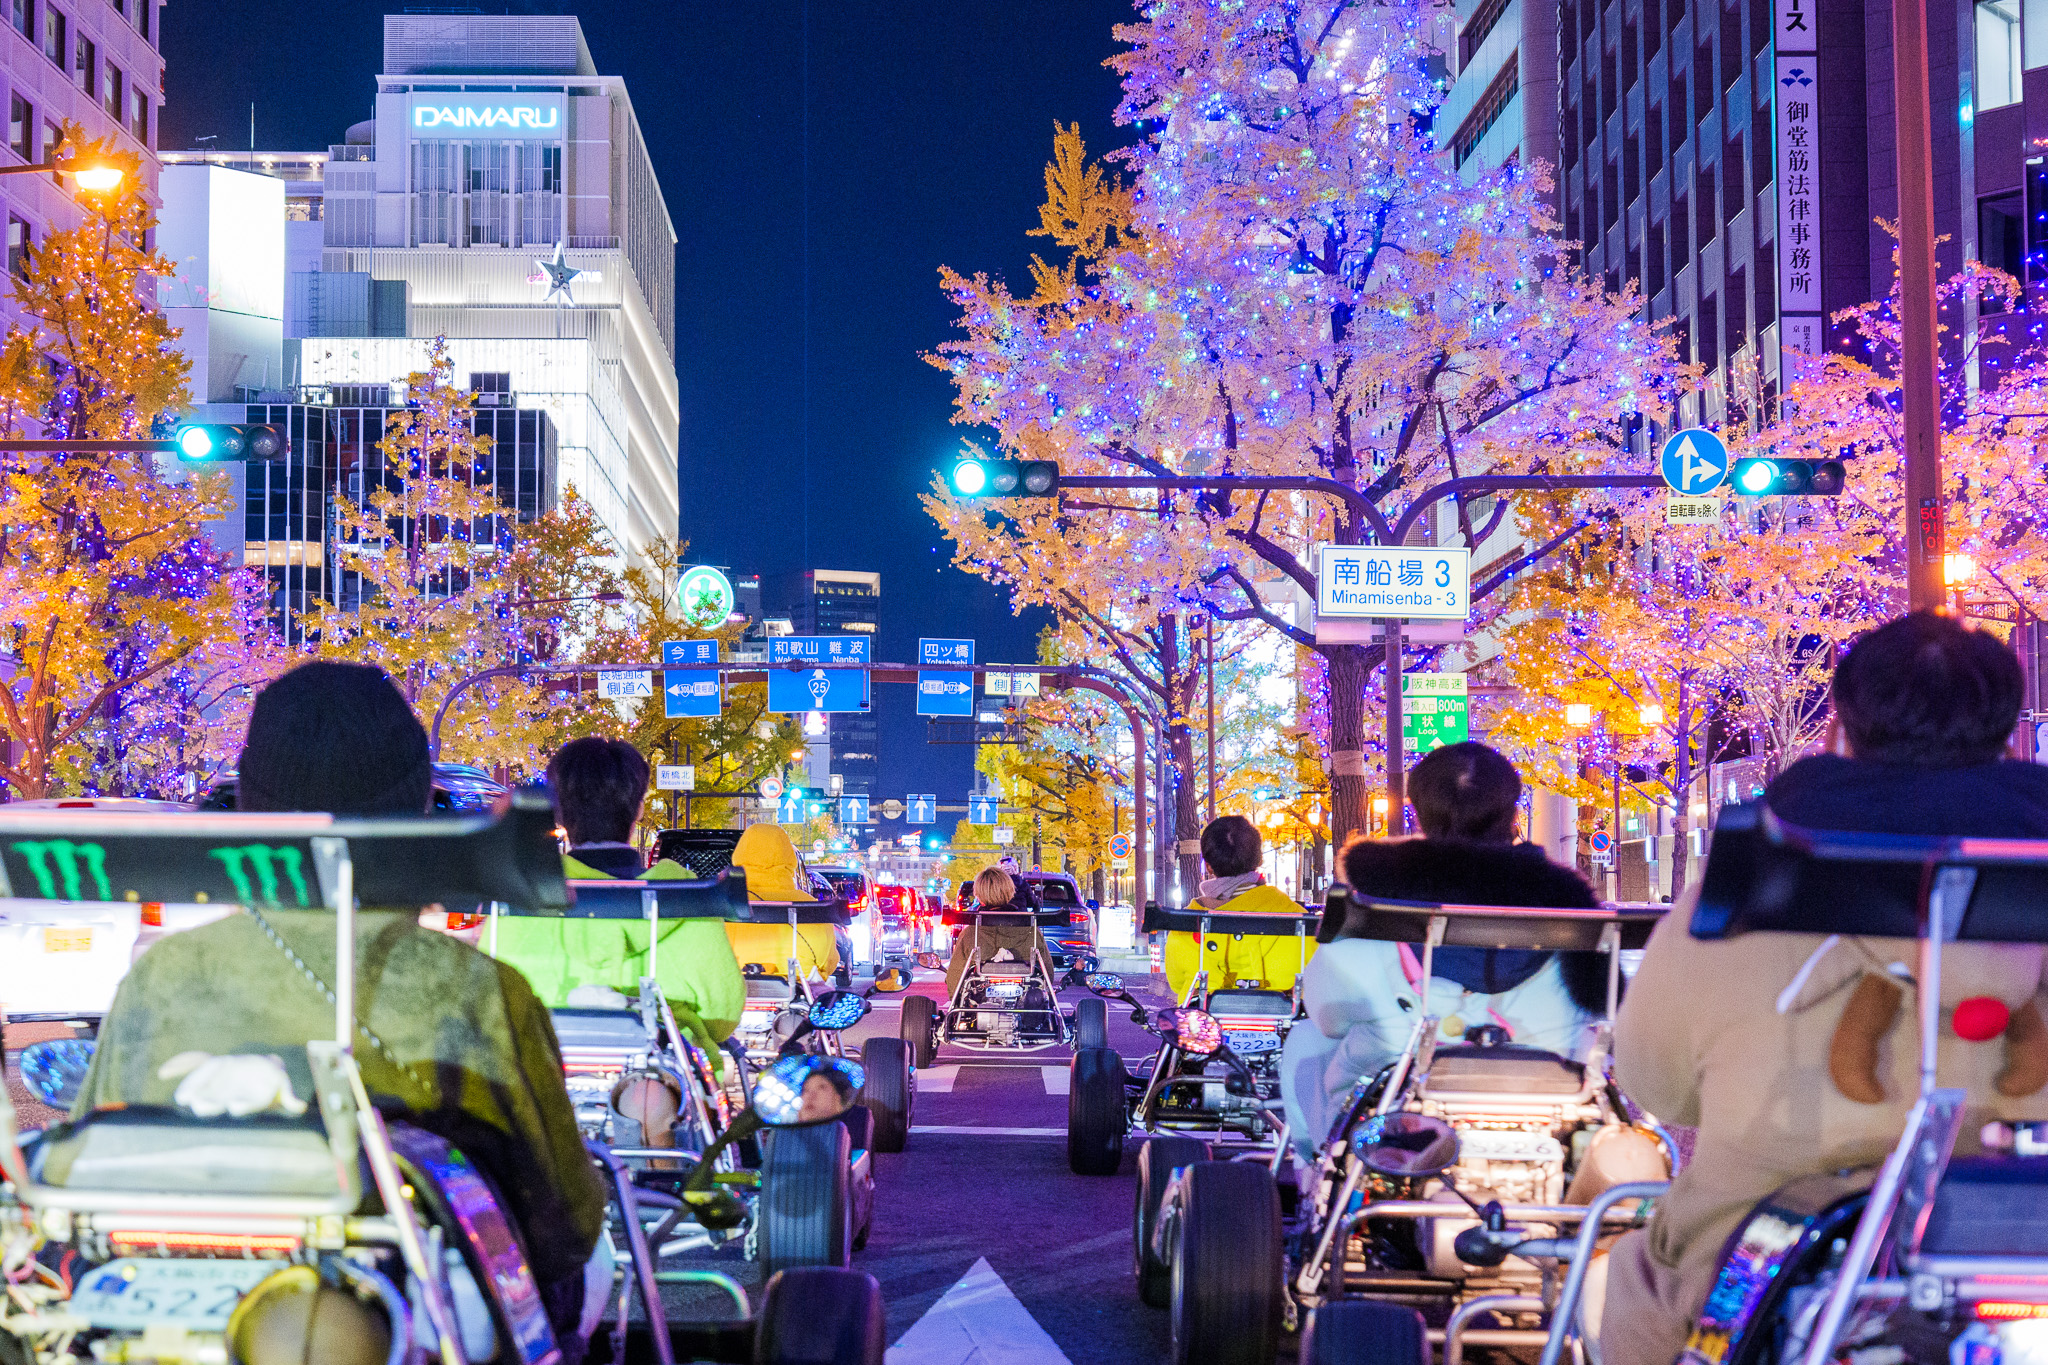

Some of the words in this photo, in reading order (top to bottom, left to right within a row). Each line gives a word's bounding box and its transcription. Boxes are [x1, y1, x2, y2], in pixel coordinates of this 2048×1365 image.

[415, 106, 558, 128] DAIMARU
[1786, 101, 1812, 294] 御堂筋法律事務所
[1670, 504, 1718, 518] 自転車を除く
[1334, 557, 1424, 587] 南船場
[1434, 559, 1451, 588] 3
[671, 644, 711, 660] 今里
[775, 640, 819, 655] 和歌山
[828, 640, 864, 655] 難波
[925, 644, 969, 658] 四ツ橋
[606, 682, 651, 696] 側道へ
[812, 681, 827, 694] 25
[1411, 678, 1463, 690] 阪神高速
[1403, 701, 1436, 712] ツ橋入口
[1438, 698, 1465, 713] 800m
[1417, 727, 1438, 736] Loop
[661, 770, 690, 779] 新橋北
[1232, 1039, 1277, 1050] 5229
[131, 1284, 243, 1317] 522
